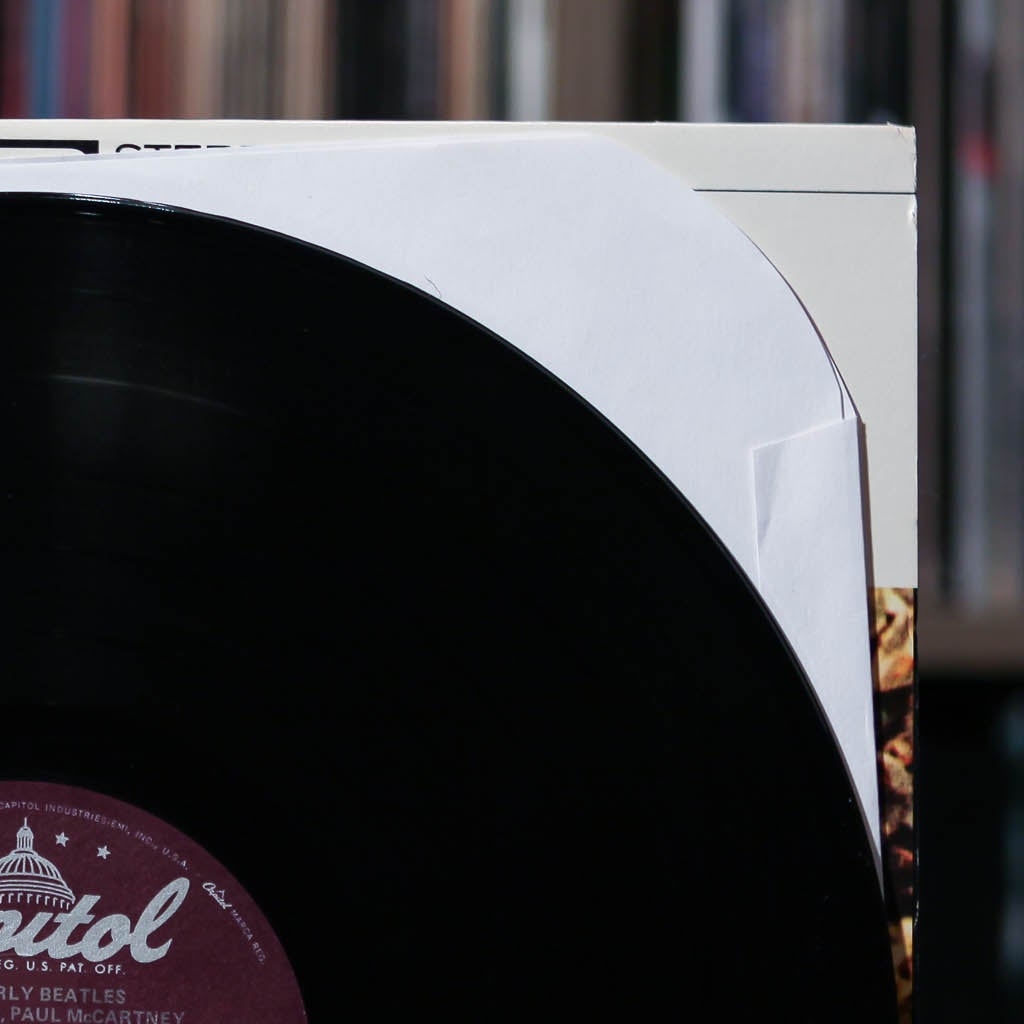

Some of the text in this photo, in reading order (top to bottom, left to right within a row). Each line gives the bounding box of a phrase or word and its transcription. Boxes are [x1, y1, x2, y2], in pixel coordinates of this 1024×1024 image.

[26, 960, 53, 972] U.S.
[59, 962, 86, 974] PAT.
[94, 964, 127, 976] OFF.
[39, 986, 126, 1005] BEATLES
[11, 1006, 61, 1023] PAUL
